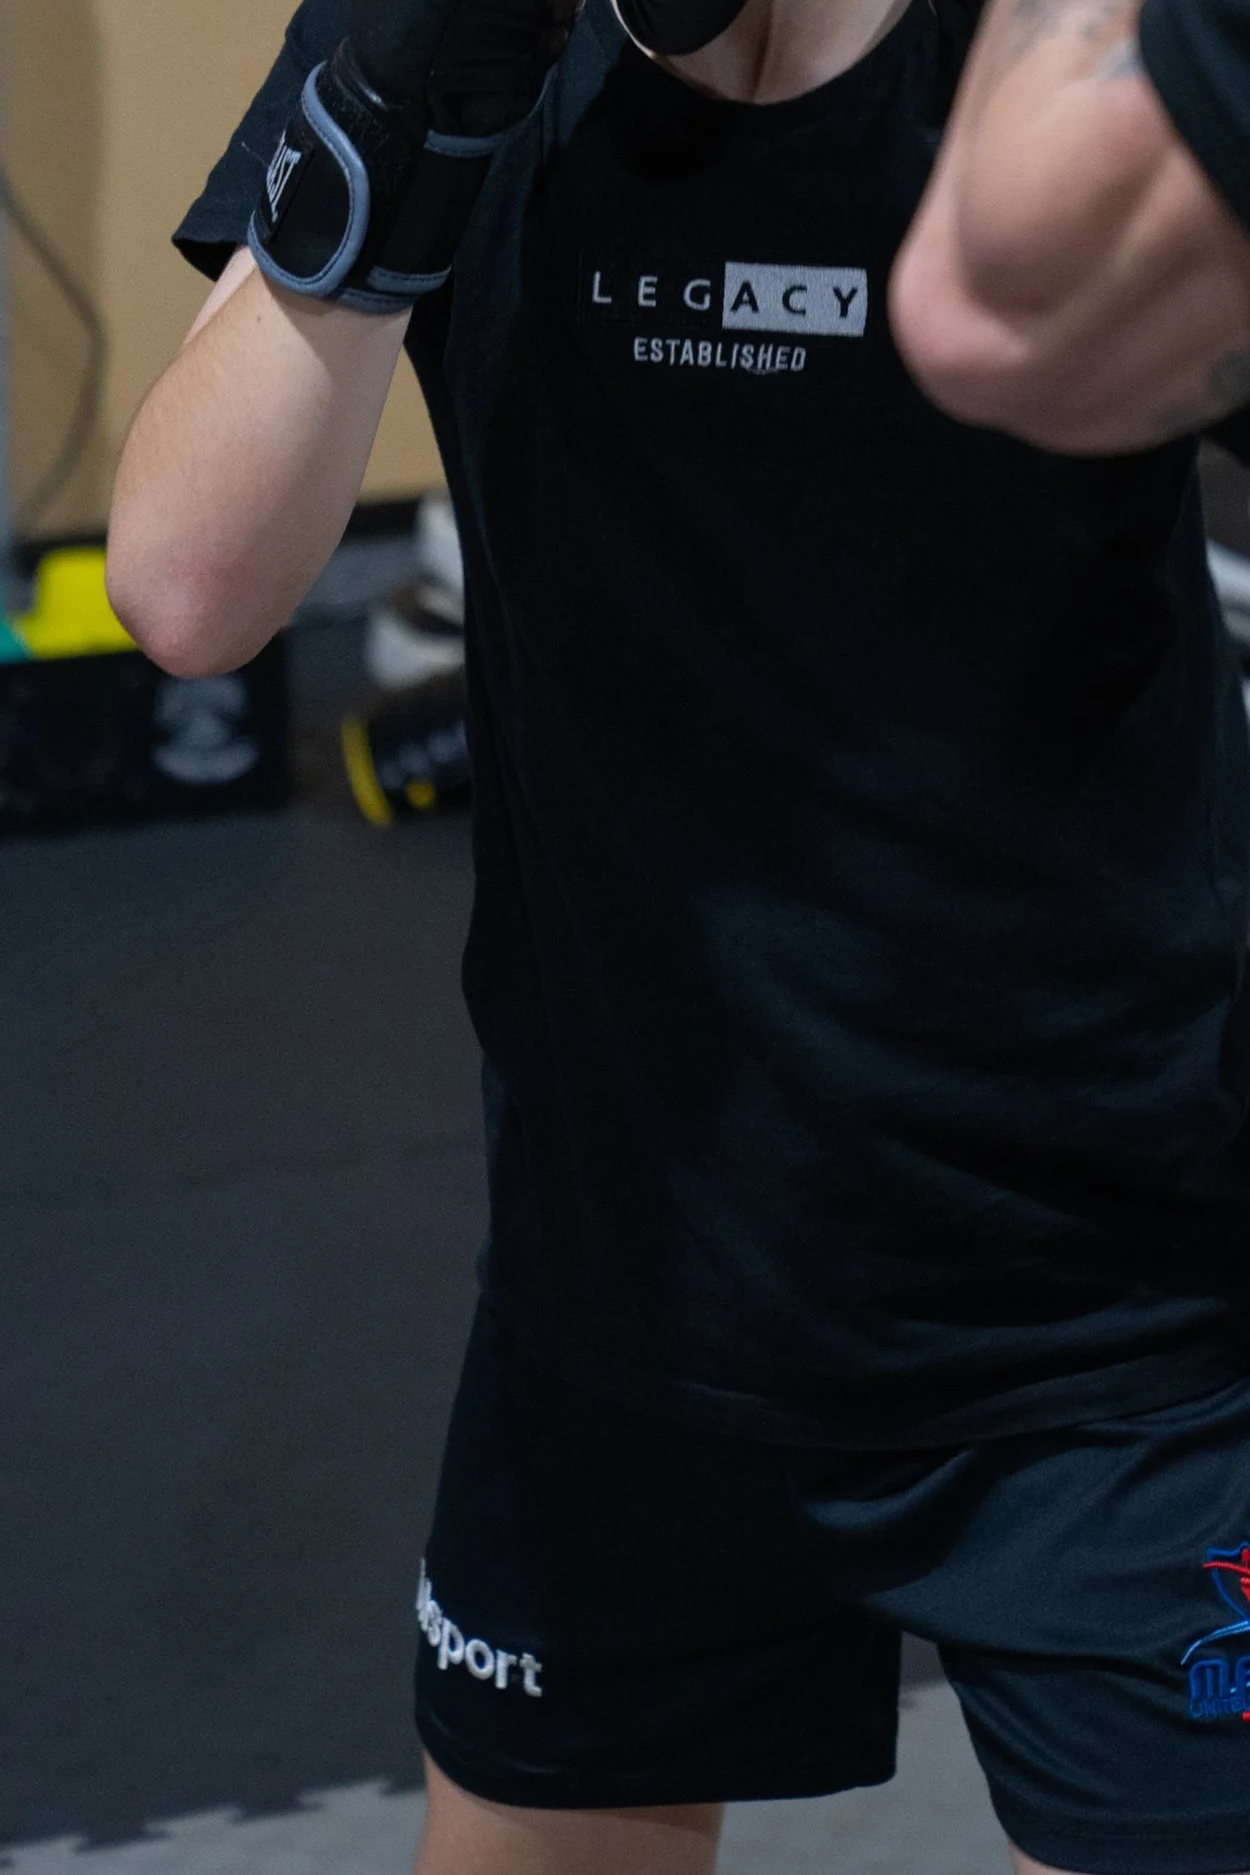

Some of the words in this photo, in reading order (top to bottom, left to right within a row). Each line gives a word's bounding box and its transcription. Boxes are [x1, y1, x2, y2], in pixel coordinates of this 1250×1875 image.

[592, 270, 858, 319] LEGACY
[633, 336, 807, 372] ESTABLISHED
[416, 1557, 543, 1698] sport
